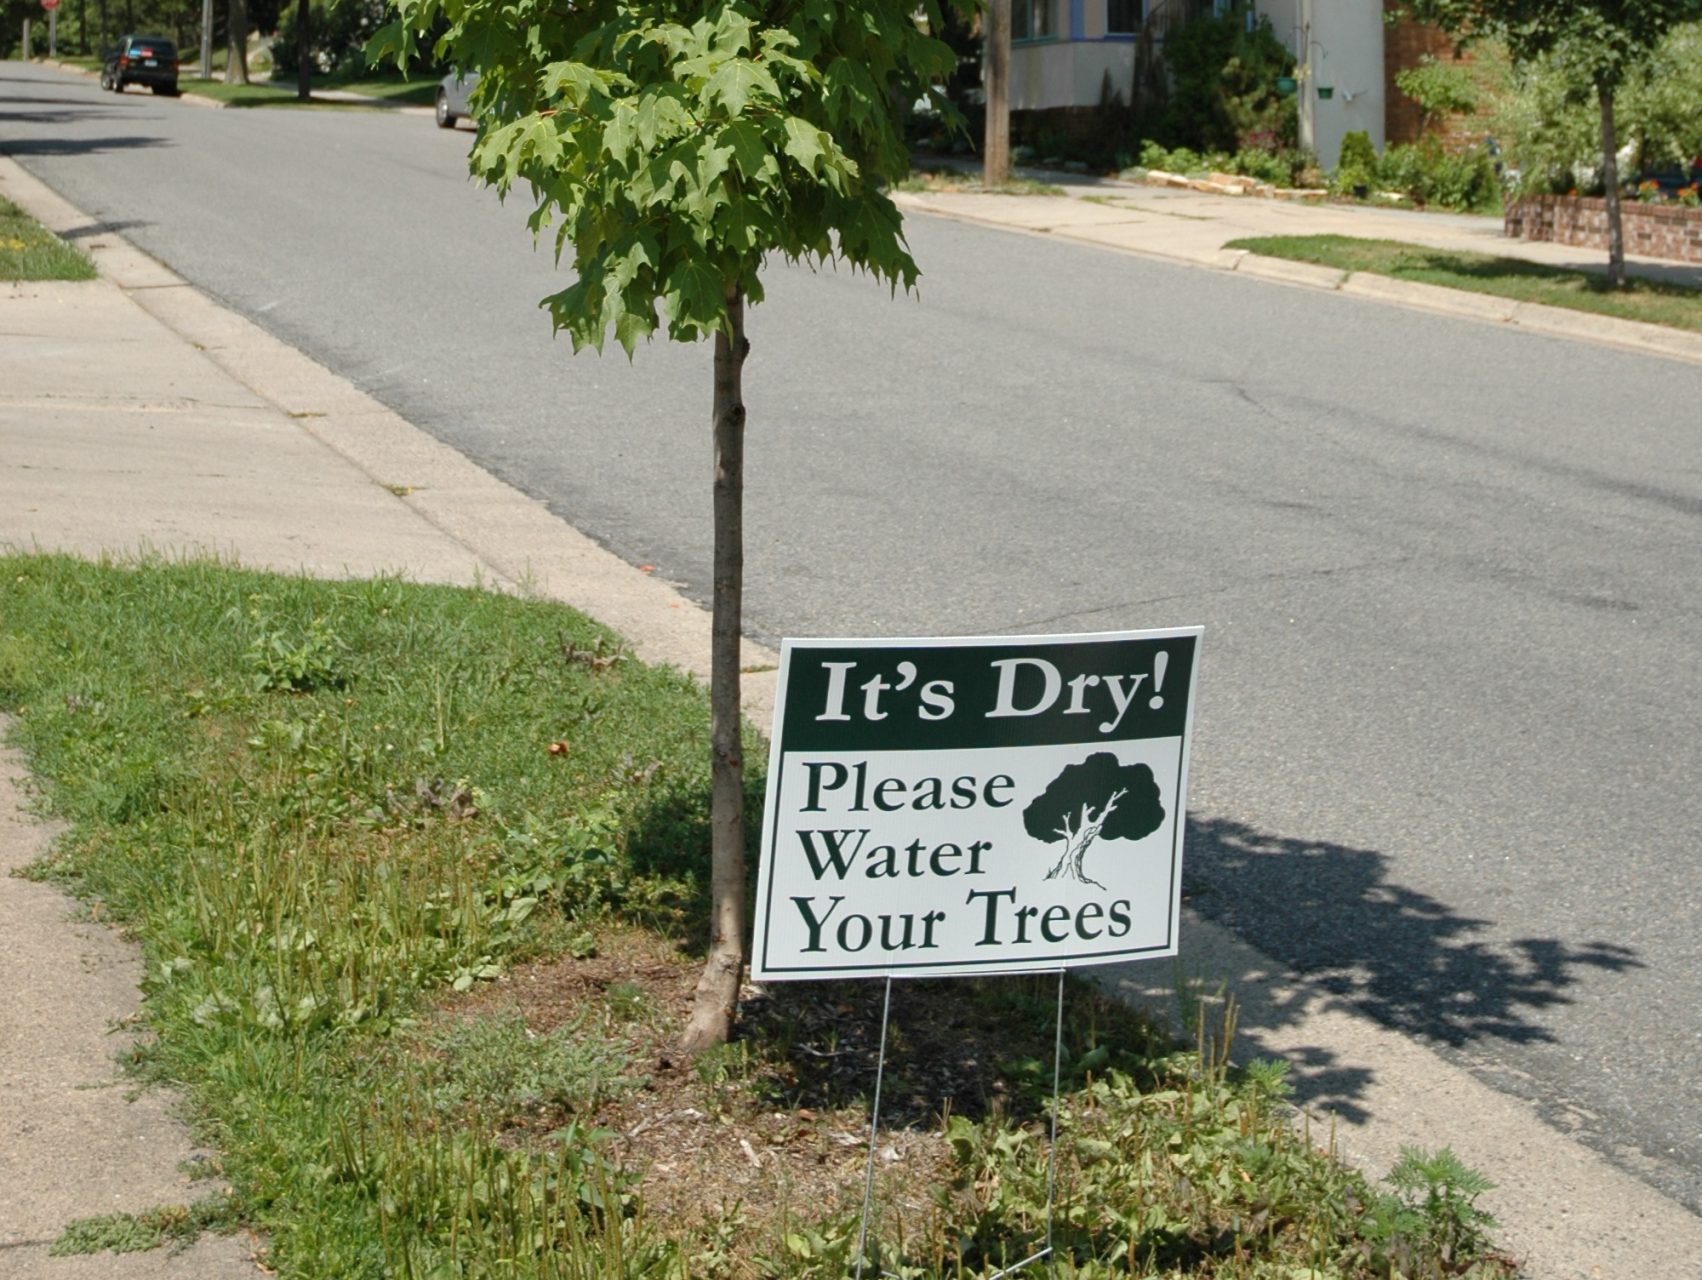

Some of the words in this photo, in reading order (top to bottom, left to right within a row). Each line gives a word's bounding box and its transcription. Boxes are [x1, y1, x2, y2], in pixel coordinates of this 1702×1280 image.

[815, 661, 955, 721] It’s
[984, 650, 1169, 733] Dry!
[799, 760, 1015, 813] Please
[795, 828, 993, 881] Water
[789, 895, 946, 953] Your
[965, 886, 1132, 947] Trees
